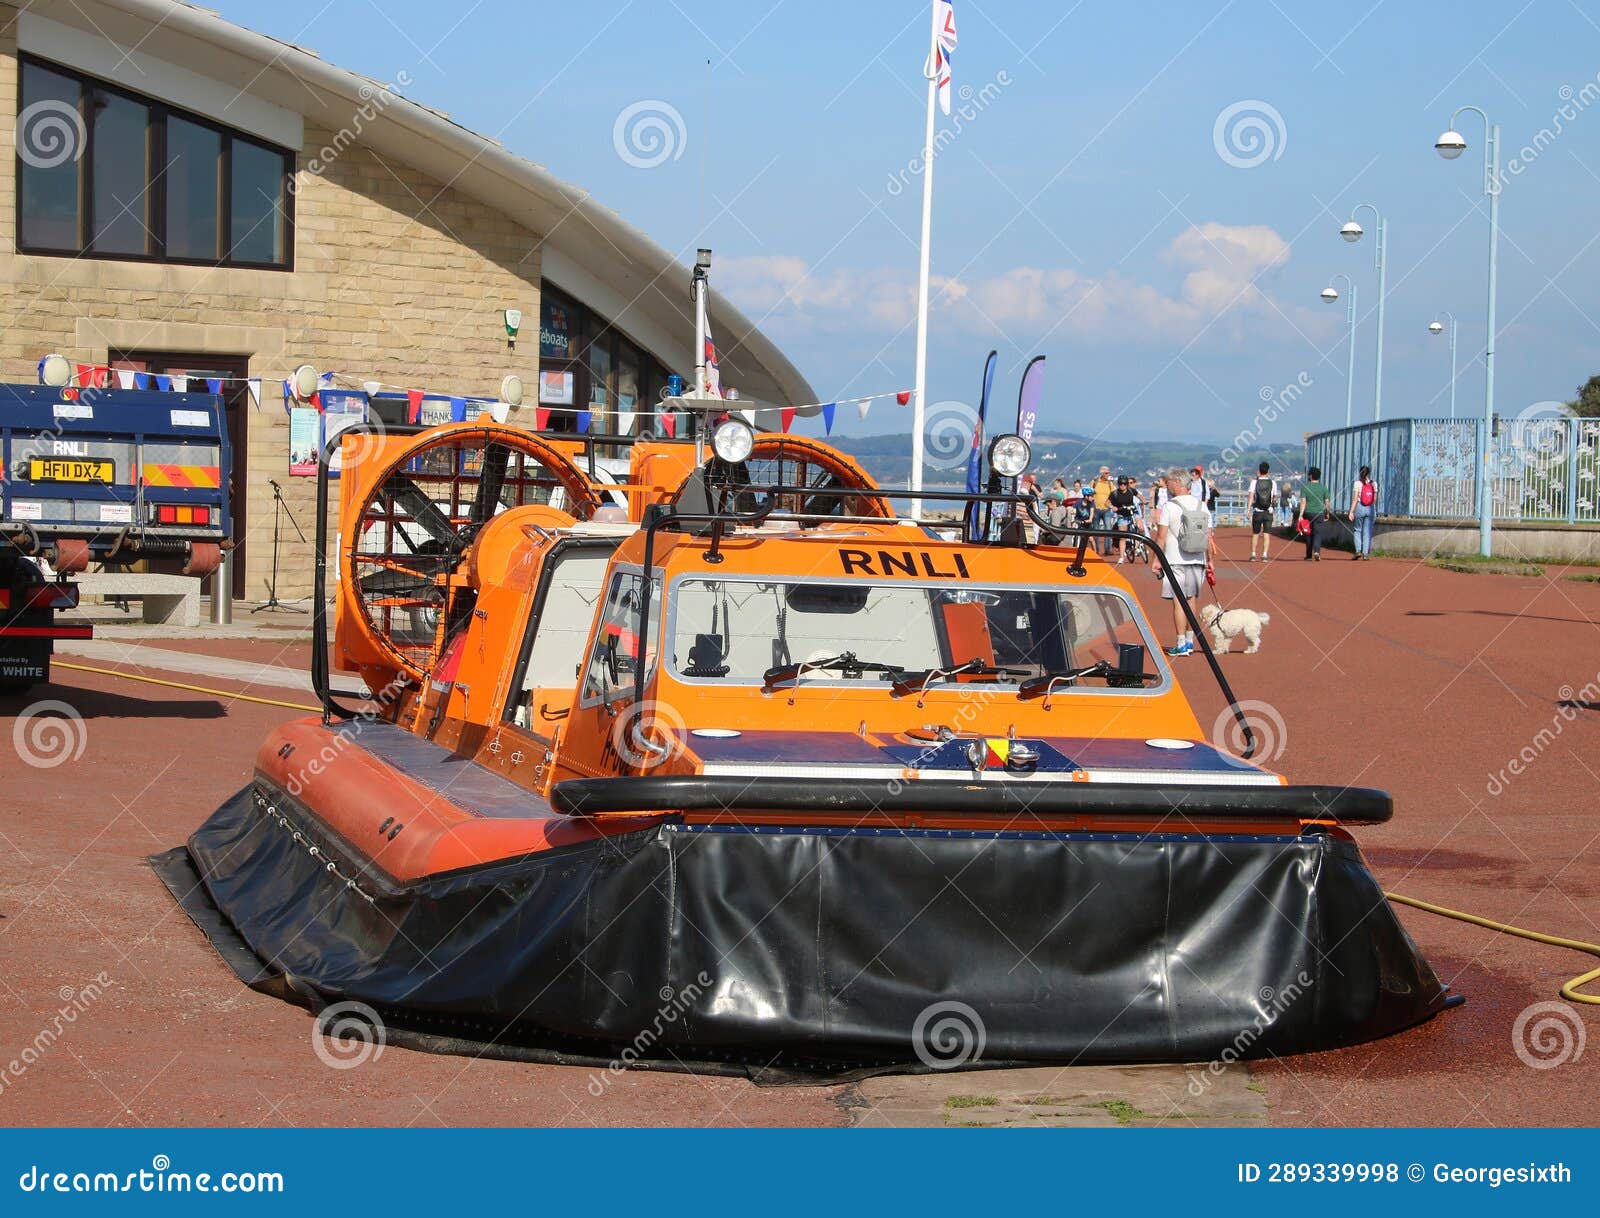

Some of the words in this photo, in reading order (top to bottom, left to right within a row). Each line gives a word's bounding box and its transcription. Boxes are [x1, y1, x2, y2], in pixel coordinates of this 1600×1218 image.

[53, 440, 88, 456] RNLI
[42, 462, 70, 478] HF11
[73, 464, 102, 479] DXZ
[838, 548, 970, 579] RNLI
[3, 666, 43, 677] WHITE
